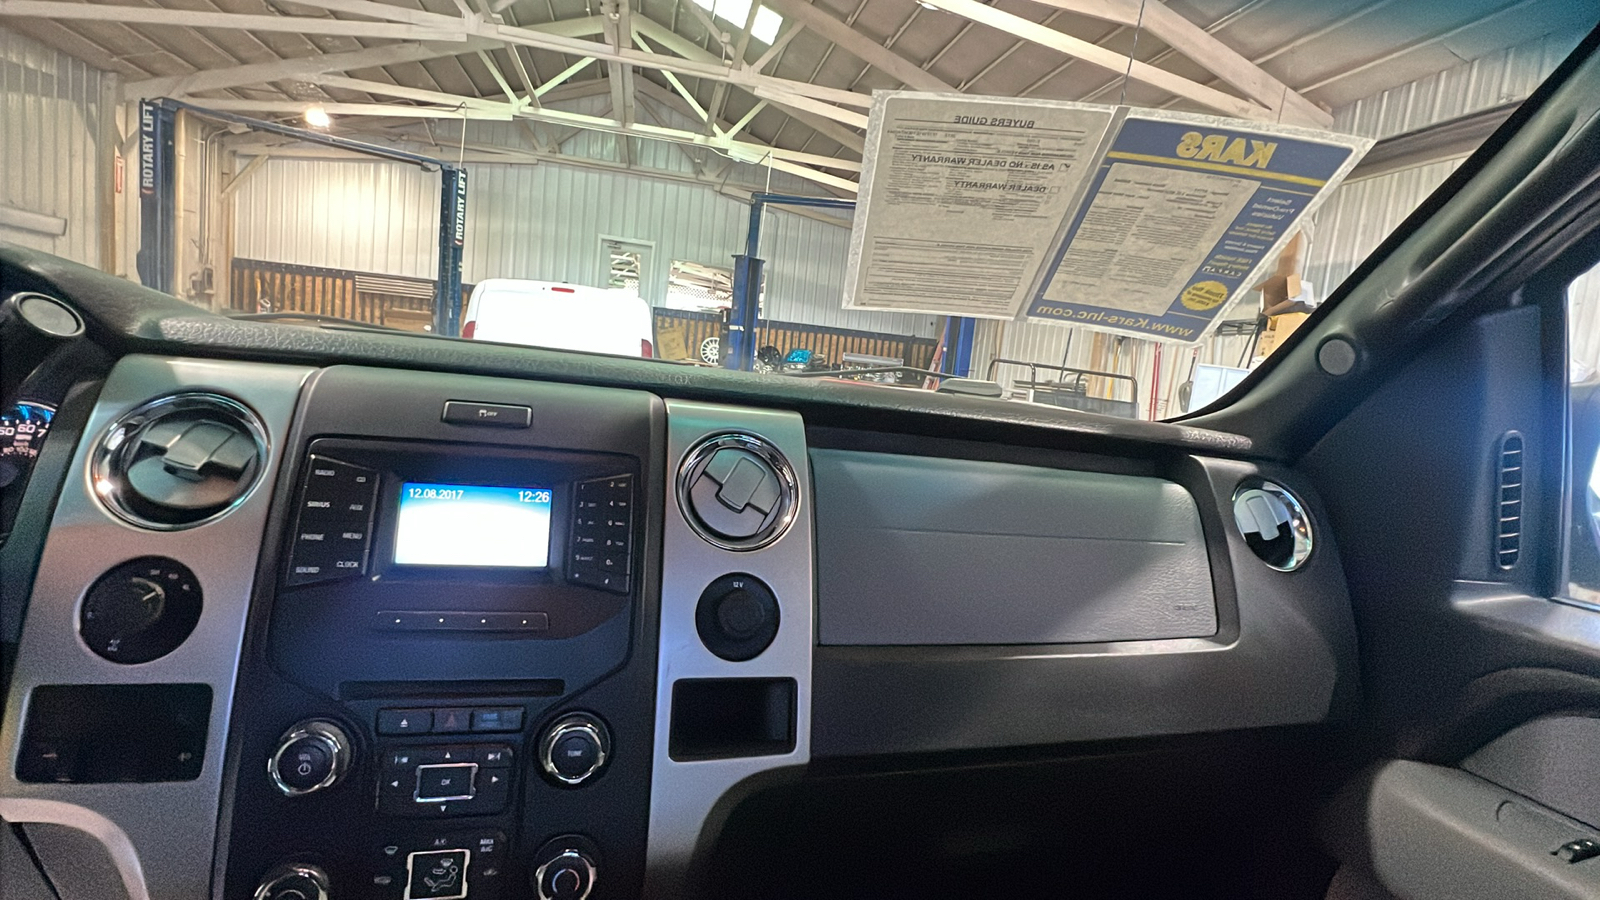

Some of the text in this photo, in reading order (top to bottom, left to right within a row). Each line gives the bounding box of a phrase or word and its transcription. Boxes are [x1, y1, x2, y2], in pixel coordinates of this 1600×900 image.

[142, 102, 154, 188] ROTARY LIFT
[455, 170, 466, 240] ROTARY LIFT
[17, 424, 36, 433] 60
[37, 428, 47, 438] 7
[408, 488, 464, 500] 12.08.2017
[518, 490, 550, 503] 12:26
